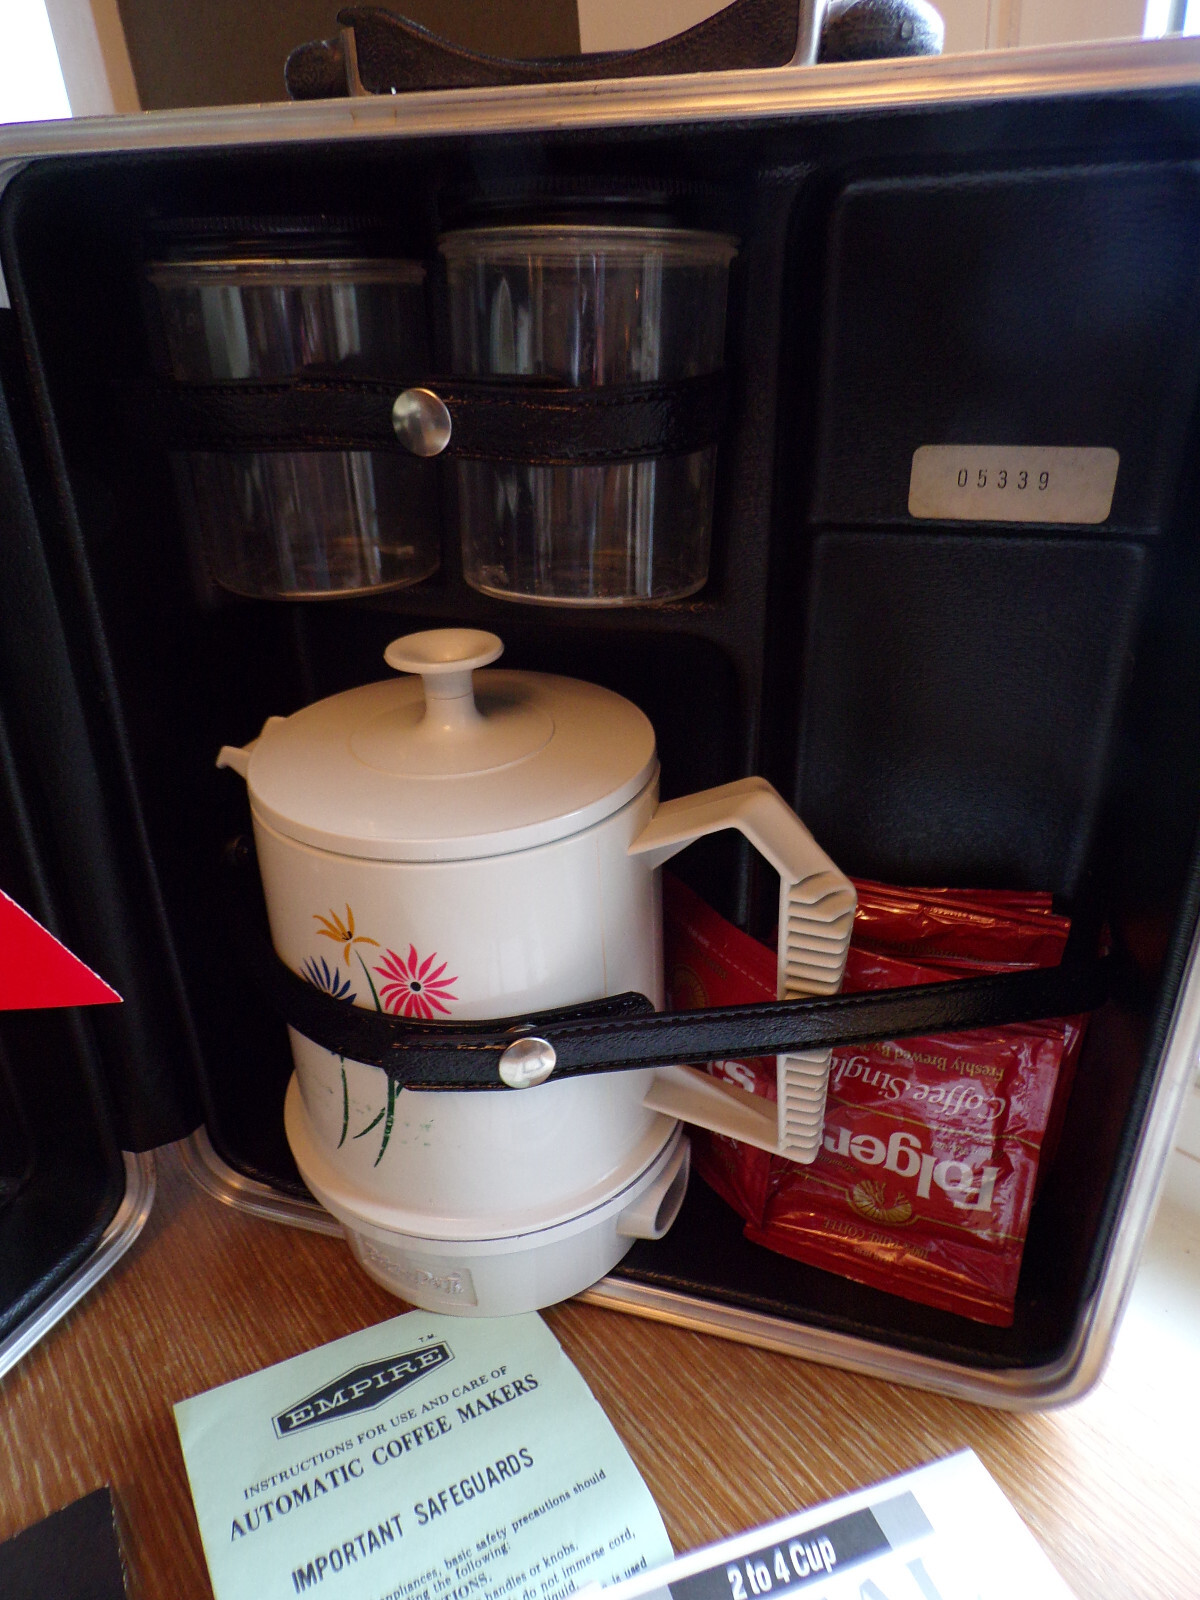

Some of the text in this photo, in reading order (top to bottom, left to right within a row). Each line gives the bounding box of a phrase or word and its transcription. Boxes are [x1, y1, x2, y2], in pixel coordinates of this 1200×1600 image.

[957, 468, 1049, 490] 05339
[828, 1055, 1006, 1121] Coffee Singl
[894, 1048, 947, 1071] Brewed
[950, 1056, 1005, 1082] Freshly
[824, 1125, 1000, 1213] Folger
[822, 1217, 867, 1242] COFFEE
[285, 1348, 443, 1429] EMPIRE
[231, 1373, 539, 1542] AUTOMATIC COFFEE MAKERS
[243, 1366, 508, 1500] INSTRUCTIONS FOR USE AND CARE OF
[291, 1447, 534, 1595] IMPORTANT SAFEGUARDS
[444, 1548, 472, 1571] basic
[475, 1526, 508, 1551] safety
[511, 1491, 571, 1533] precautions
[572, 1468, 607, 1493] should
[432, 1577, 452, 1593] the
[484, 1571, 528, 1600] handles
[529, 1563, 541, 1578] or
[542, 1541, 579, 1569] knobs.
[540, 1572, 560, 1596] not
[561, 1546, 606, 1580] immerse
[608, 1526, 636, 1551] cord,
[624, 1555, 648, 1577] used
[726, 1563, 748, 1600] 2
[744, 1556, 773, 1597] to
[773, 1547, 791, 1585] 4
[789, 1535, 837, 1578] Cup
